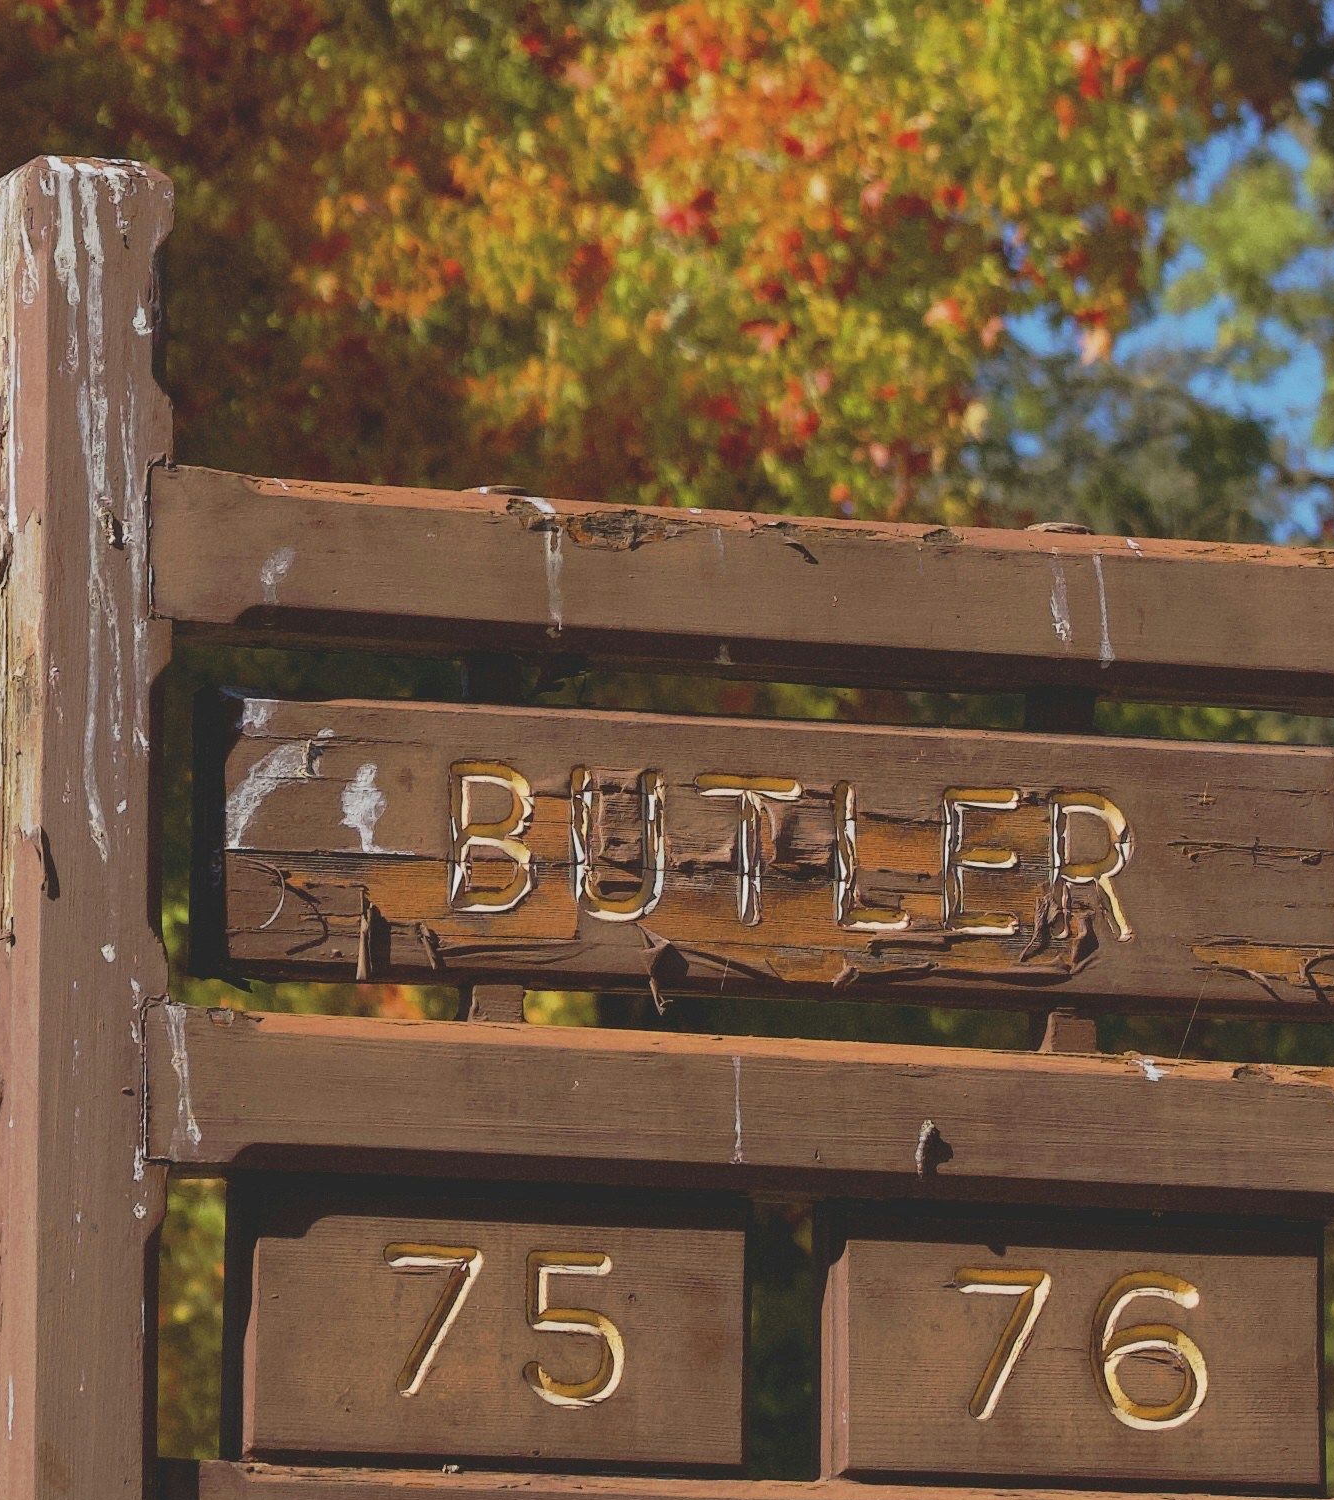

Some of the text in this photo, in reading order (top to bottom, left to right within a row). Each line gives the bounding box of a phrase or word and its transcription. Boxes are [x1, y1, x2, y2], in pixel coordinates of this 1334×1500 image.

[446, 757, 1136, 943] BUTLER
[383, 1242, 625, 1410] 75
[955, 1267, 1209, 1432] 76
